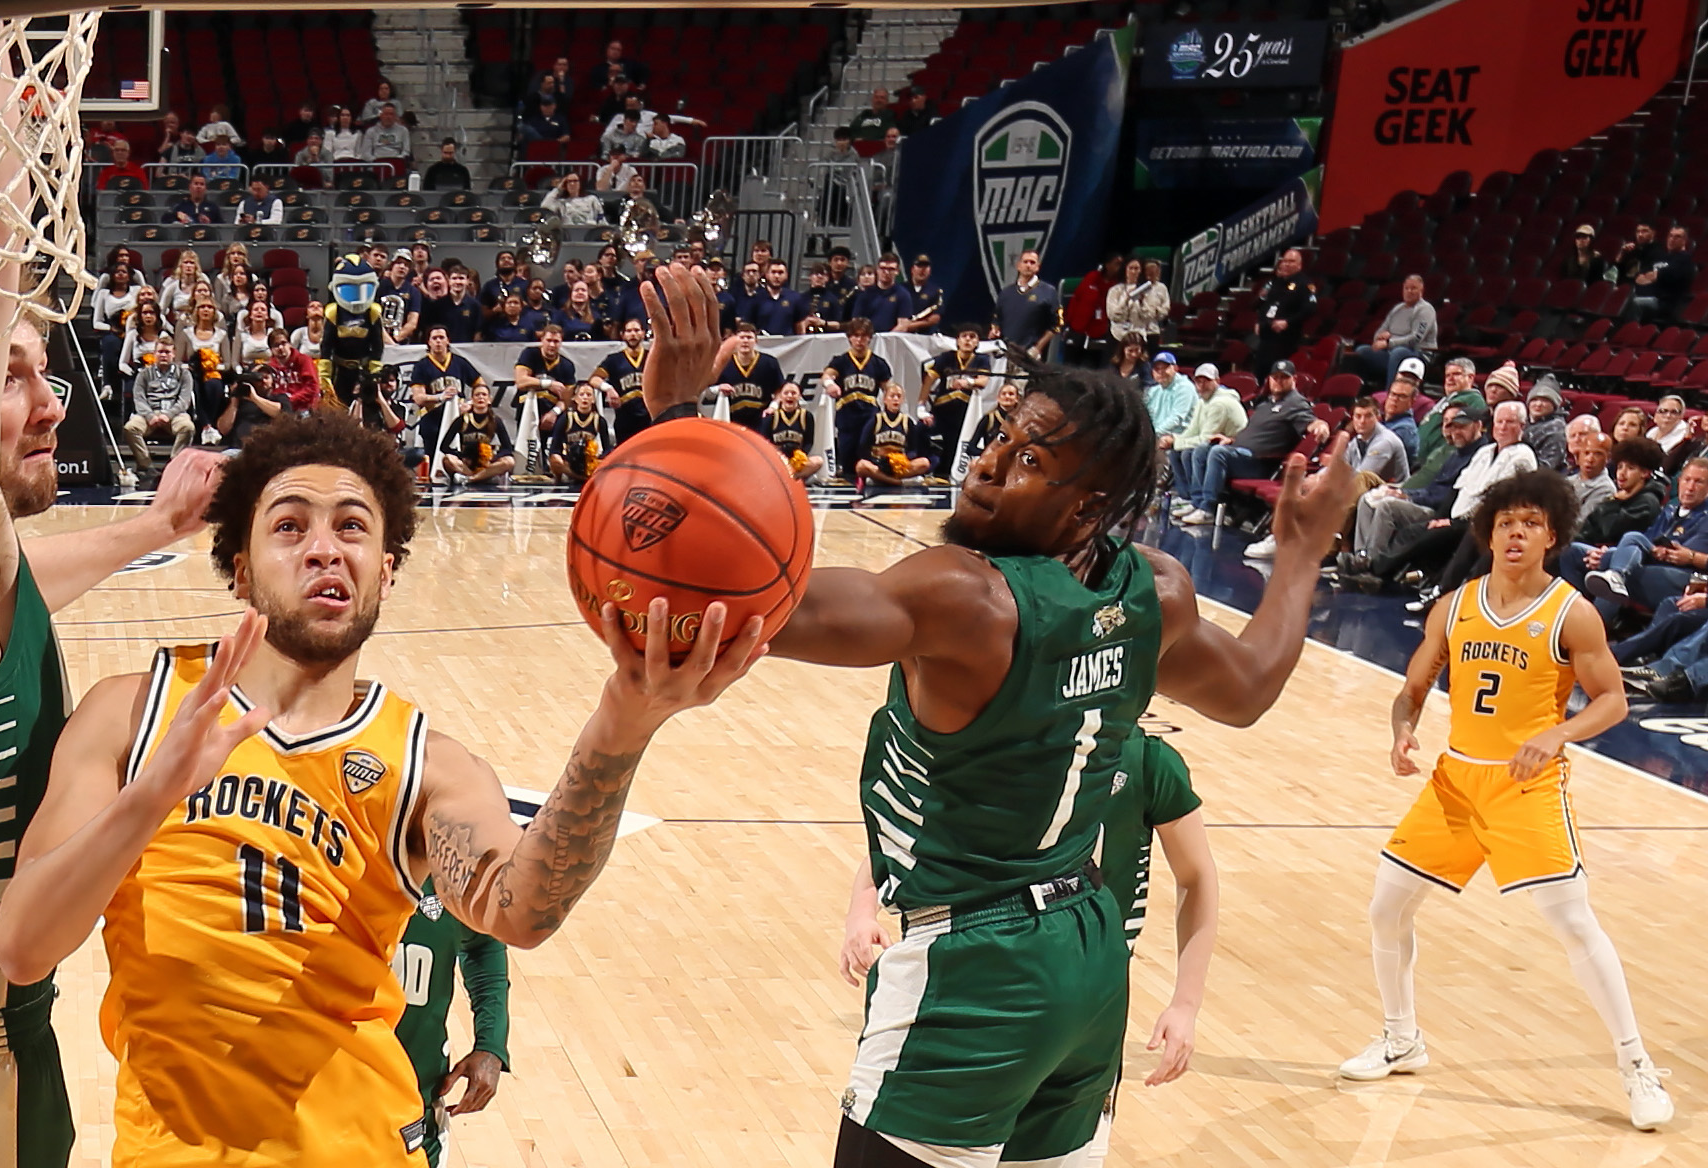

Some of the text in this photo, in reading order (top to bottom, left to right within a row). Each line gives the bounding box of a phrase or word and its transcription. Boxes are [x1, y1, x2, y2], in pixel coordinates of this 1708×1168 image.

[1201, 32, 1261, 78] 25
[1564, 28, 1647, 79] GEEK
[1385, 66, 1480, 104] SEAT
[1374, 107, 1476, 146] GEEK
[978, 175, 1059, 225] MAC
[1226, 191, 1295, 250] BASKETBALL
[1221, 213, 1299, 275] TOURNAMENT
[844, 373, 876, 392] TOLEDO
[875, 429, 905, 445] TOLEDO
[622, 504, 676, 533] MAC
[1062, 646, 1124, 699] JAMES
[1461, 641, 1530, 671] ROCKETS
[1473, 671, 1502, 716] 2
[344, 761, 380, 783] MAC
[1036, 708, 1103, 851] 1
[184, 775, 350, 868] ROCKETS
[237, 843, 308, 934] 11
